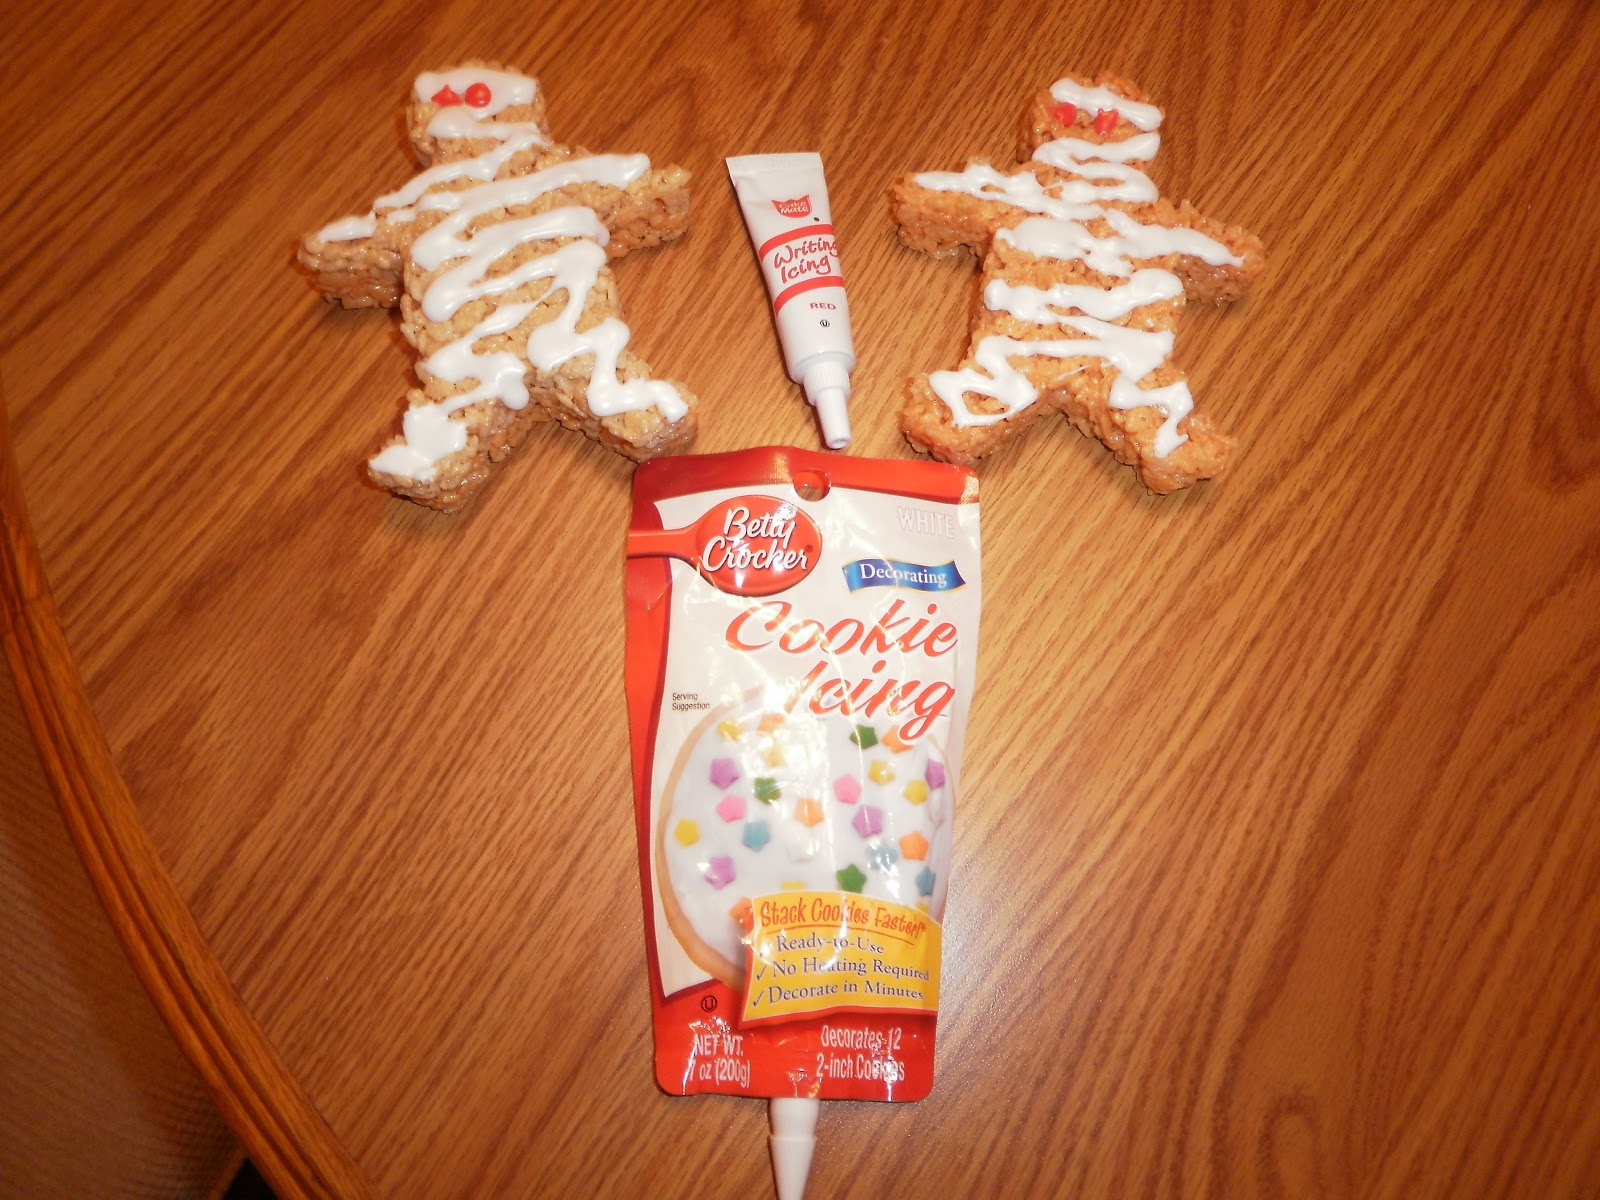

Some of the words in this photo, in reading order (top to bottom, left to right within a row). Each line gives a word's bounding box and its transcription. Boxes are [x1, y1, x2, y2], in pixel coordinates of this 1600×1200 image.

[780, 206, 809, 214] Mate
[774, 237, 839, 269] Writing
[781, 255, 831, 283] Icing
[810, 302, 836, 310] RED
[723, 506, 796, 549] Betty
[898, 506, 955, 539] WHITE
[702, 535, 807, 572] Crocker
[860, 563, 947, 588] Decorating
[726, 599, 958, 657] Cookie
[672, 693, 698, 701] Serving
[672, 702, 710, 711] Suggestion
[785, 660, 956, 741] Icing
[760, 897, 807, 928] Stack
[811, 898, 869, 925] Cookies
[776, 932, 885, 954] Ready-to-Use
[773, 960, 797, 977] No
[803, 957, 867, 976] Heating
[873, 959, 930, 981] Required
[768, 983, 838, 1004] Decorate
[843, 980, 858, 993] in
[864, 980, 924, 999] Minutes
[694, 1034, 720, 1056] NET
[722, 1034, 744, 1056] WT.
[821, 1025, 883, 1049] Decorates
[888, 1027, 902, 1049] 12
[699, 1063, 712, 1081] oz
[715, 1058, 751, 1088] (200g)
[816, 1052, 853, 1079] 2-inch
[857, 1052, 905, 1081] Cookes
